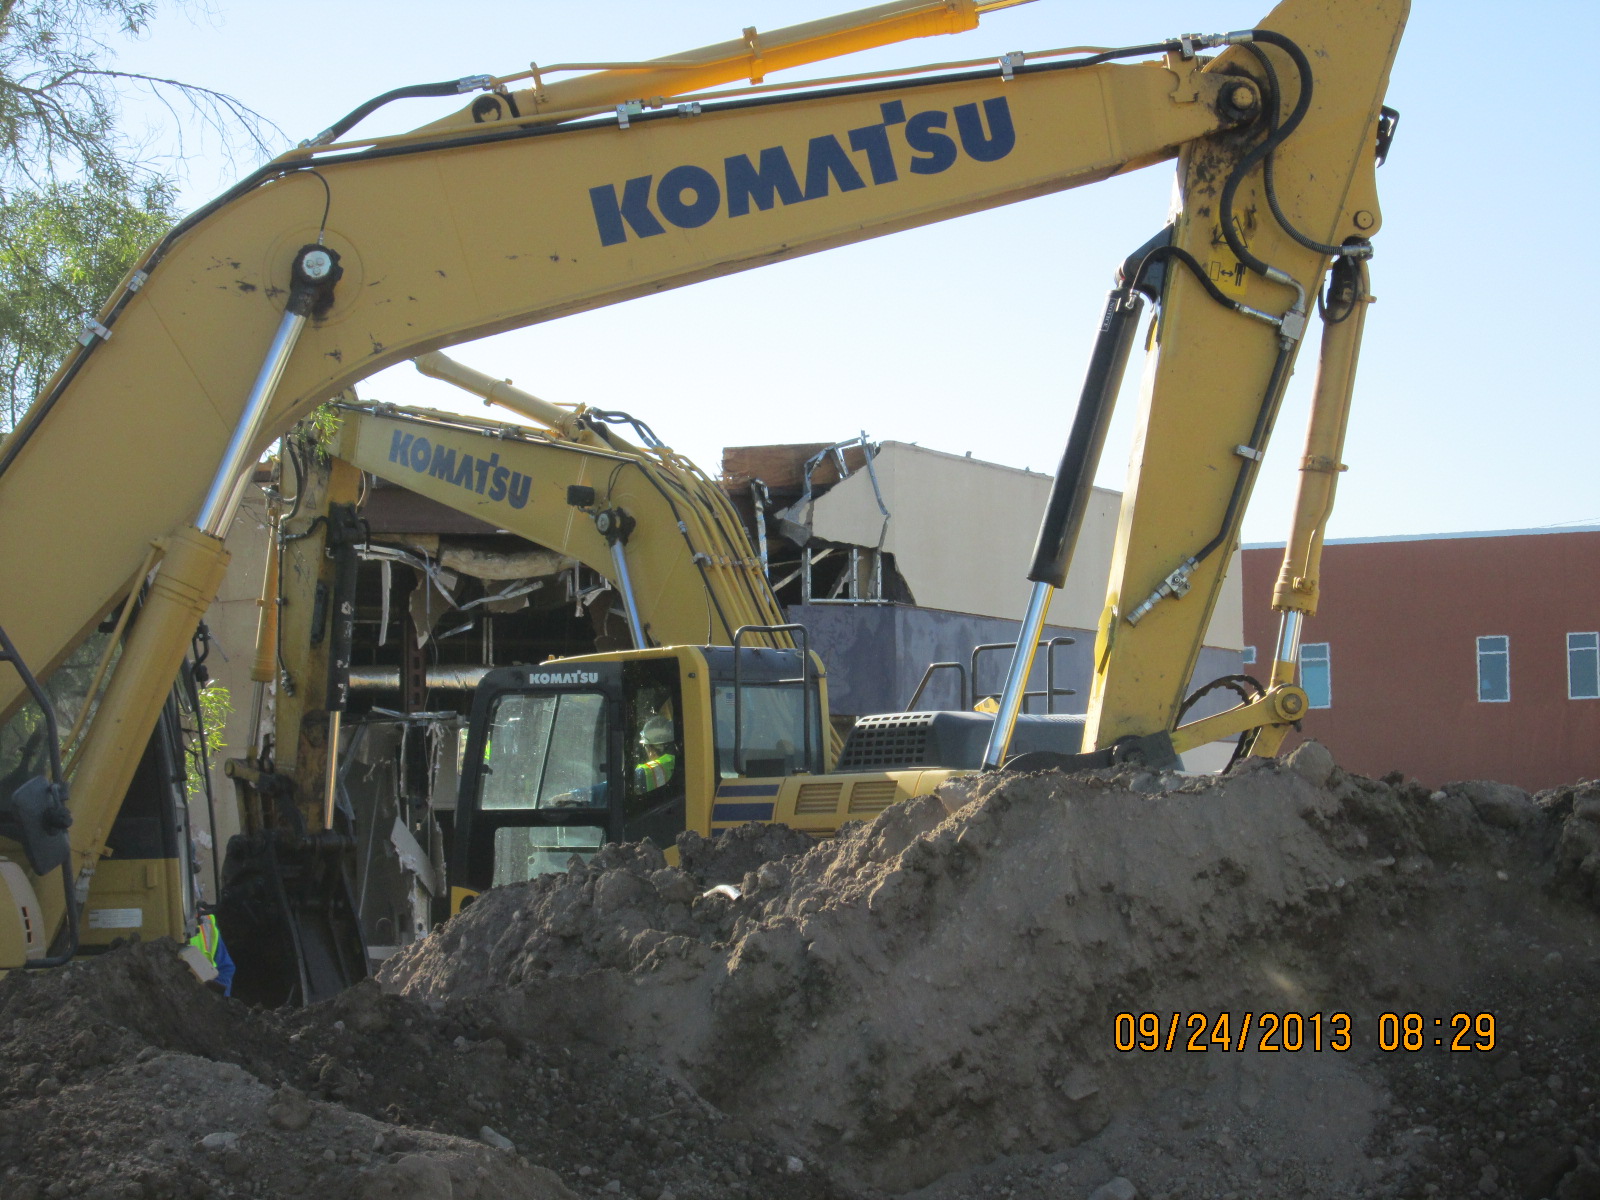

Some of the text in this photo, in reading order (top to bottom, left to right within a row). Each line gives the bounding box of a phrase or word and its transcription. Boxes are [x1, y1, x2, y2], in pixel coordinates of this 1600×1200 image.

[589, 96, 1016, 247] KOMATSU
[1102, 301, 1116, 328] NOTICE
[388, 429, 532, 509] KOMATSU
[529, 669, 599, 684] KOMATSU
